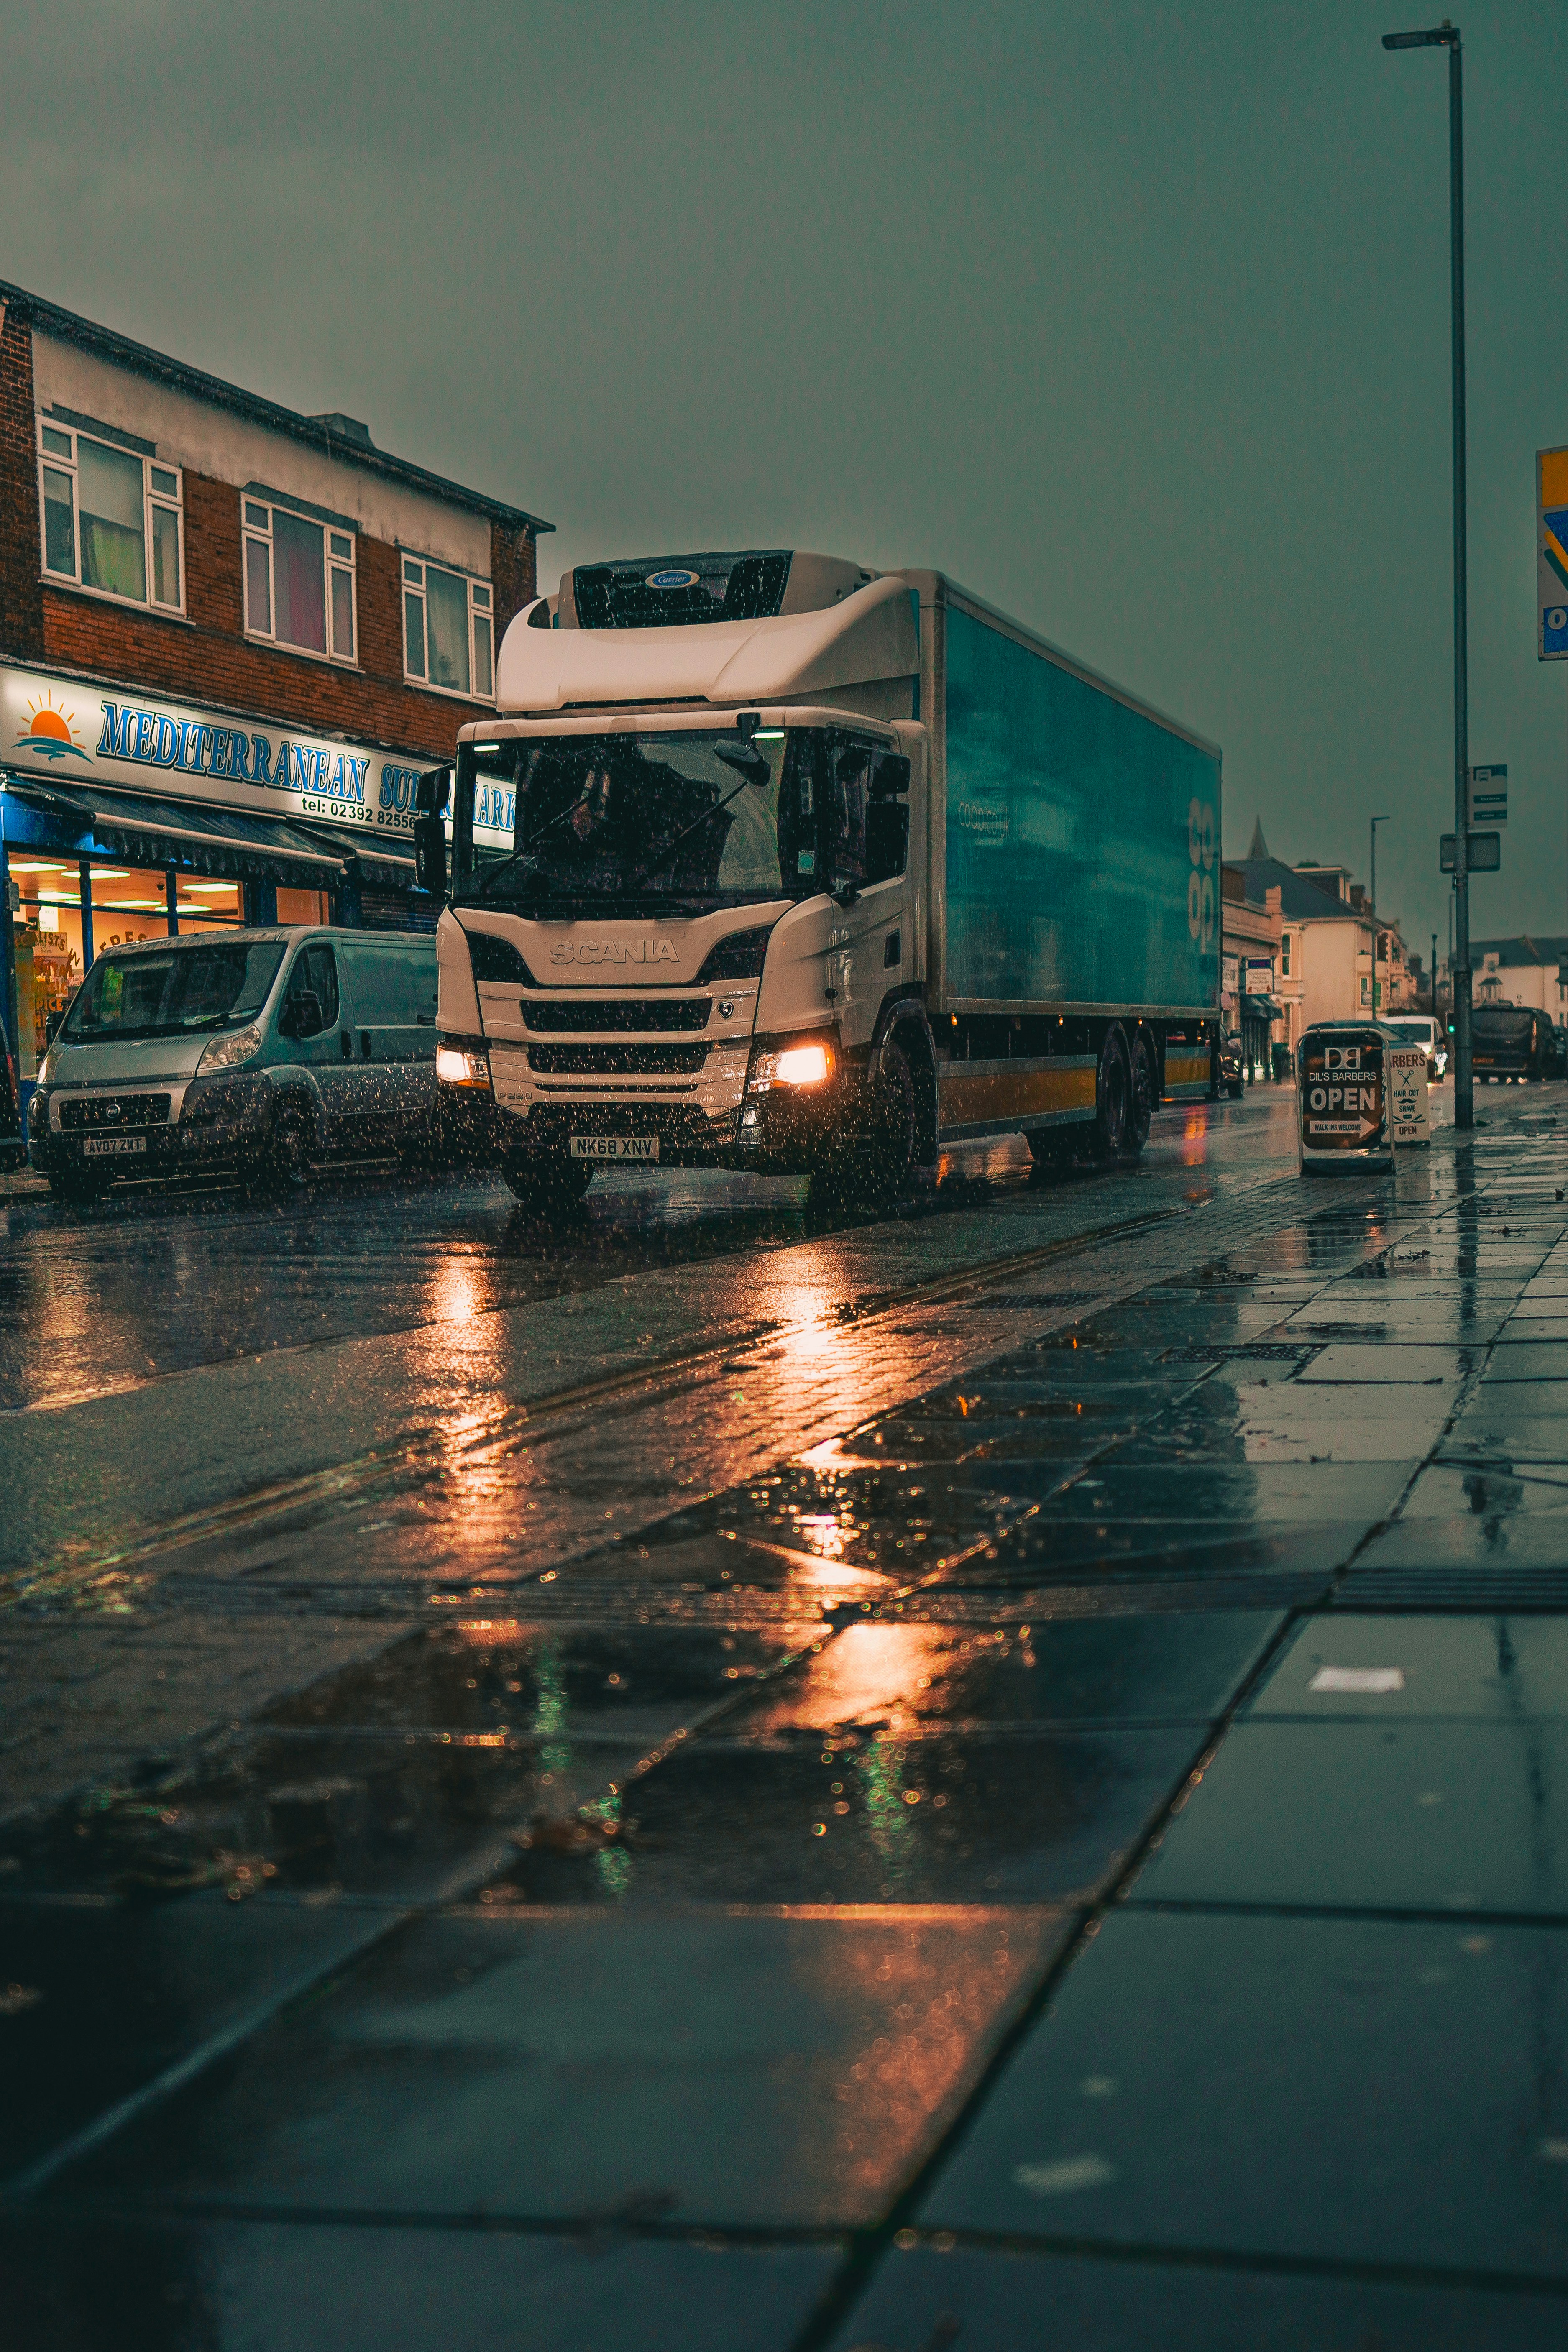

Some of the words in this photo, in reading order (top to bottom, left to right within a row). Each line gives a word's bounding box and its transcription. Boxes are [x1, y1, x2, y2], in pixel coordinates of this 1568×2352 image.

[658, 575, 686, 583] Carrier
[96, 700, 370, 805] MEDITERRANEAN
[302, 797, 326, 813] tel:
[330, 803, 373, 823] 02392
[377, 810, 415, 830] 82556
[549, 940, 680, 964] SCANIA
[1309, 1072, 1329, 1081] DIL'S
[1332, 1072, 1376, 1081] BARBERS
[1310, 1088, 1375, 1110] OPEN
[1399, 1125, 1417, 1135] OPEN
[577, 1139, 617, 1154] NK68
[622, 1140, 652, 1155] XNV
